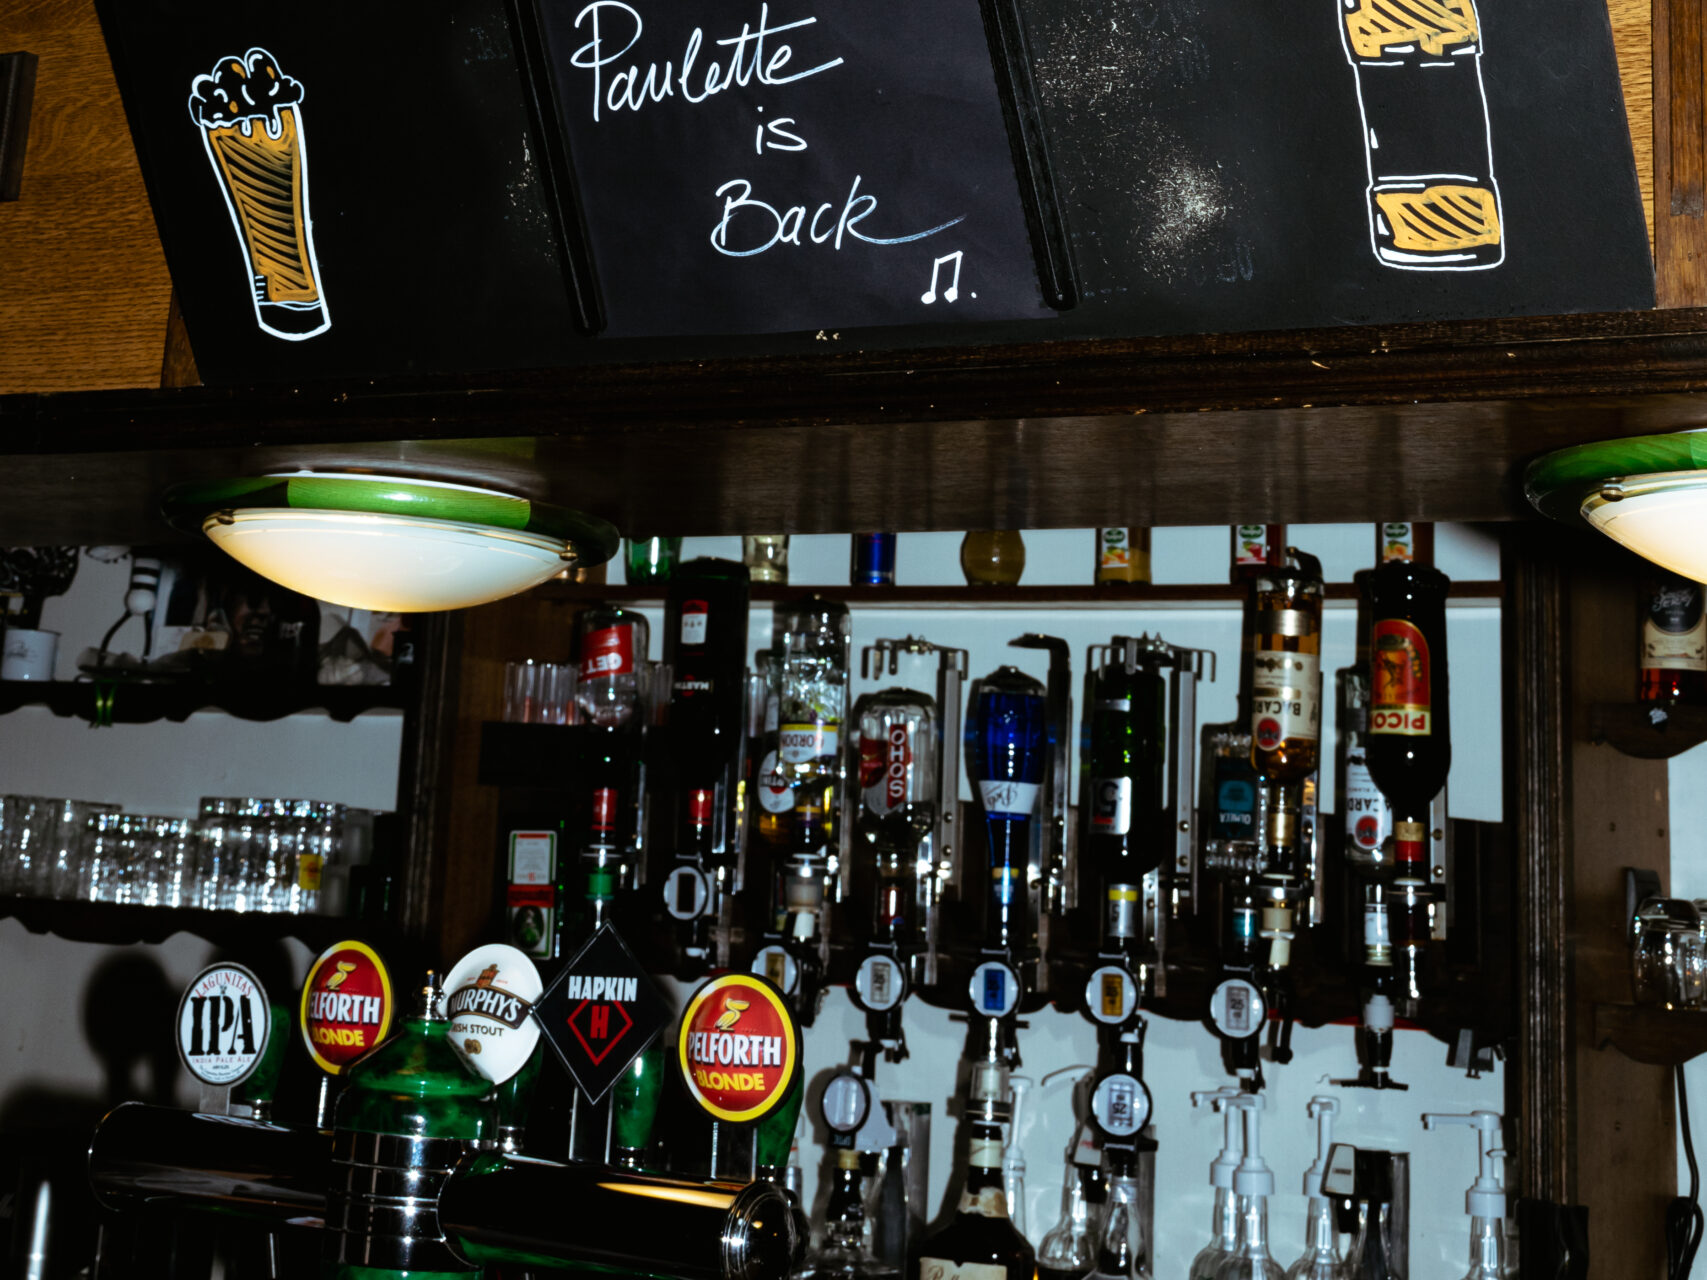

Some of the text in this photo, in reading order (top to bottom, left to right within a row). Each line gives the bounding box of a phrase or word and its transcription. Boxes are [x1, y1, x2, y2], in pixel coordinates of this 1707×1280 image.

[570, 0, 845, 122] Paulette
[755, 105, 808, 155] is
[710, 175, 967, 257] Back
[586, 652, 623, 674] GET
[1371, 712, 1426, 730] PICO
[888, 729, 906, 798] SOHO
[195, 971, 253, 999] LAGUNITAS
[568, 975, 638, 1002] HAPKIN
[310, 991, 381, 1024] ELFORTH
[450, 988, 523, 1023] MURPHY'S
[590, 1005, 610, 1039] H
[188, 995, 257, 1056] IPA
[470, 1023, 505, 1037] STOUT
[192, 1055, 252, 1064] INDIA PALE ALE
[688, 1031, 782, 1067] PELFORTH
[697, 1070, 766, 1091] BLONDE
